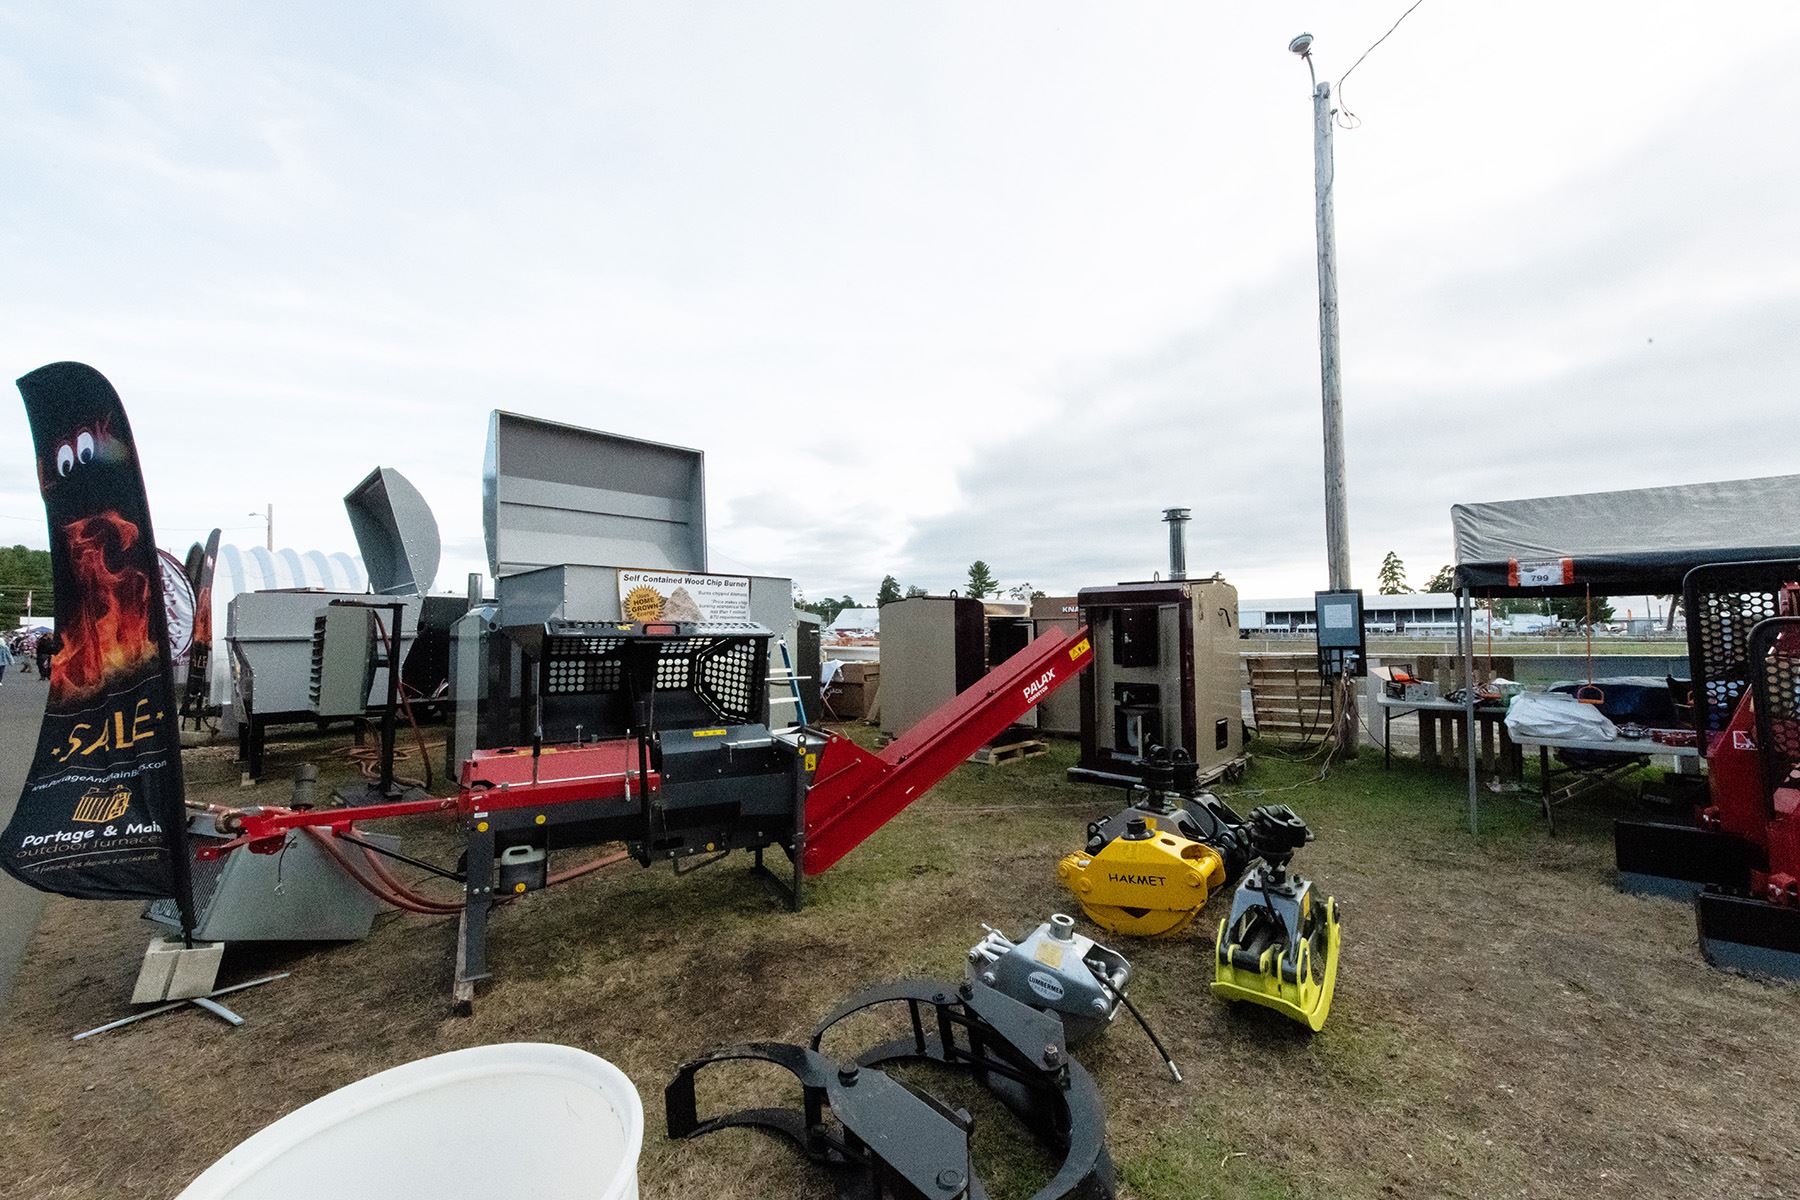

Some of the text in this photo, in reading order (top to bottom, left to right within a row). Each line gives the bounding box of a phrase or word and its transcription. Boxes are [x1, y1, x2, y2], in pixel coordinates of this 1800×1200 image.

[623, 573, 748, 588] Self Contained Wood Chip Burner
[1530, 574, 1549, 582] 799
[631, 603, 659, 613] GROWN
[633, 596, 655, 606] HOME
[636, 610, 656, 618] Energy
[1023, 668, 1056, 699] PALAX
[59, 698, 154, 762] SALE
[21, 820, 162, 848] Portage & Main
[16, 842, 88, 858] outdoor
[1108, 873, 1167, 887] HAKMET
[1029, 975, 1063, 995] LUMBERMEN
